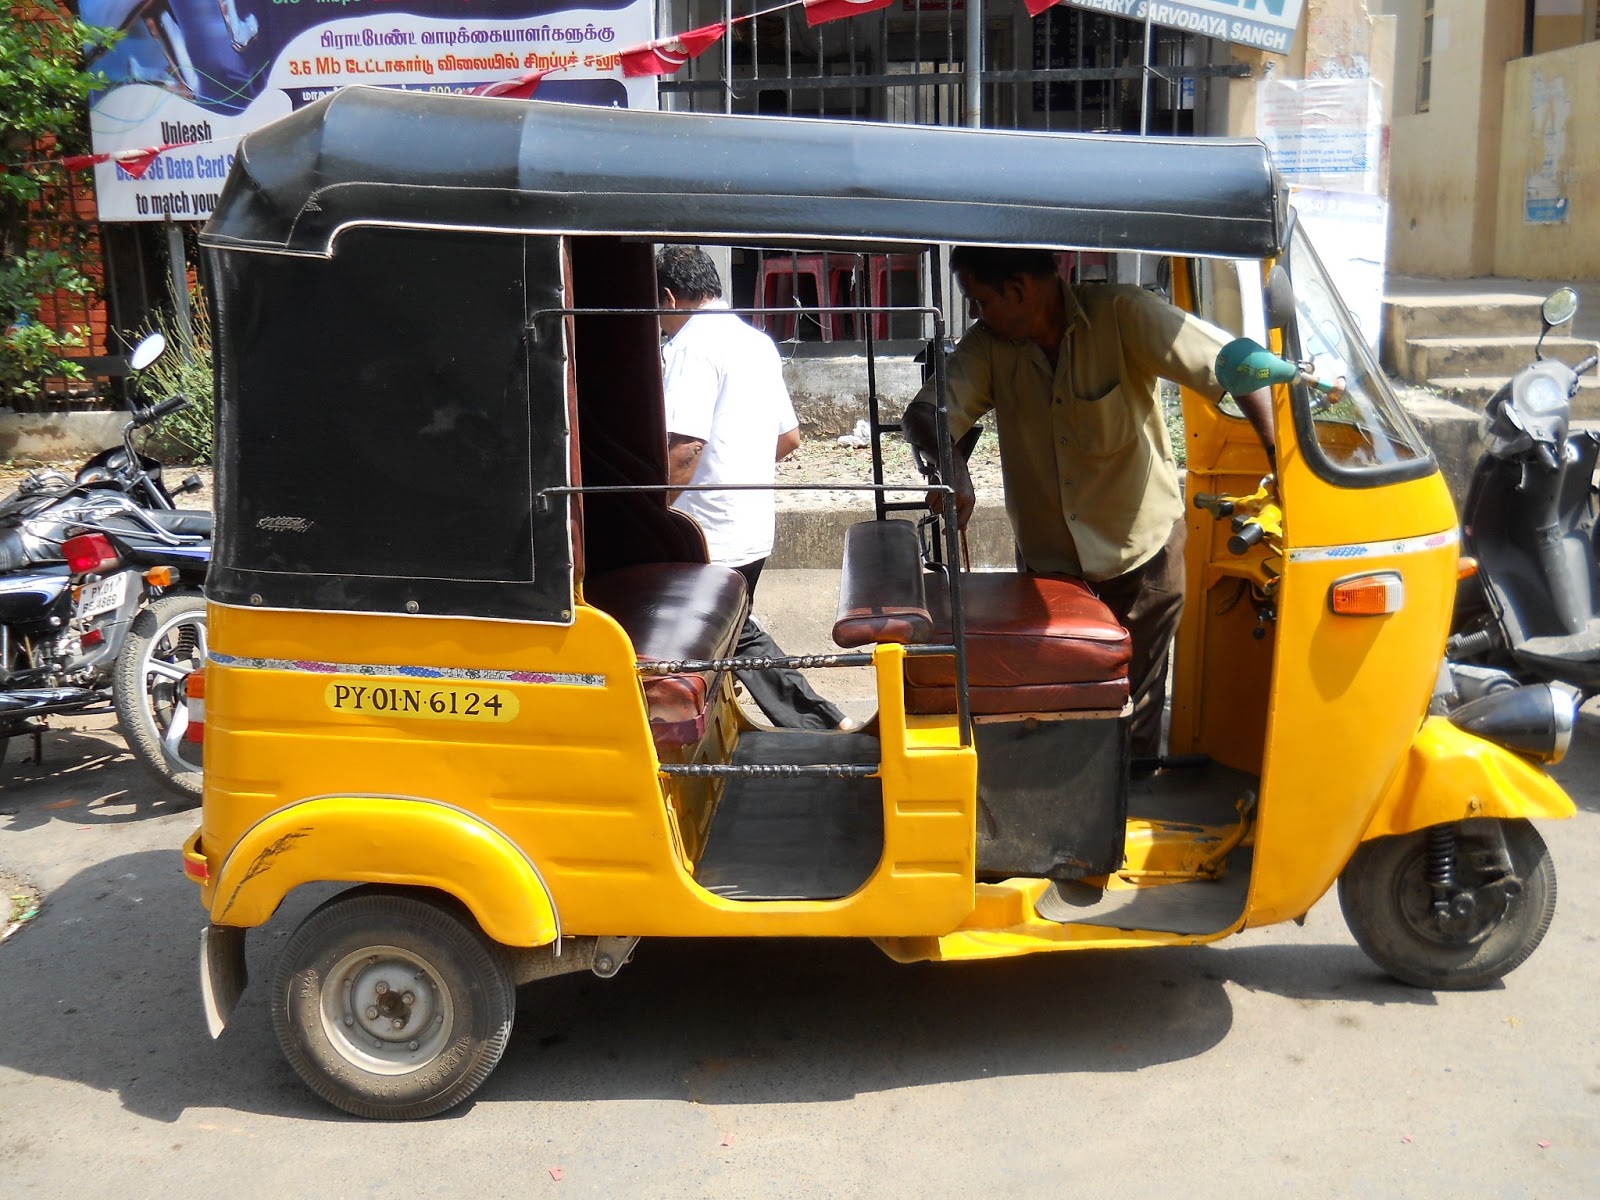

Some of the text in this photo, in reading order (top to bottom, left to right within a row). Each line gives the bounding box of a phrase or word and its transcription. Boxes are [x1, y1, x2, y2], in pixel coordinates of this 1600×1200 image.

[421, 23, 615, 46] வாடிக்கையாளர்களுக்கு
[1136, 0, 1227, 38] SARVODAYA
[1230, 22, 1287, 49] SANGH
[290, 61, 312, 75] 3.6
[316, 57, 341, 74] Mb
[437, 52, 519, 71] விலையில்
[160, 120, 213, 145] Unleash
[148, 156, 164, 180] 3G
[165, 156, 194, 179] Data
[196, 154, 226, 179] Card
[136, 191, 219, 215] to match your
